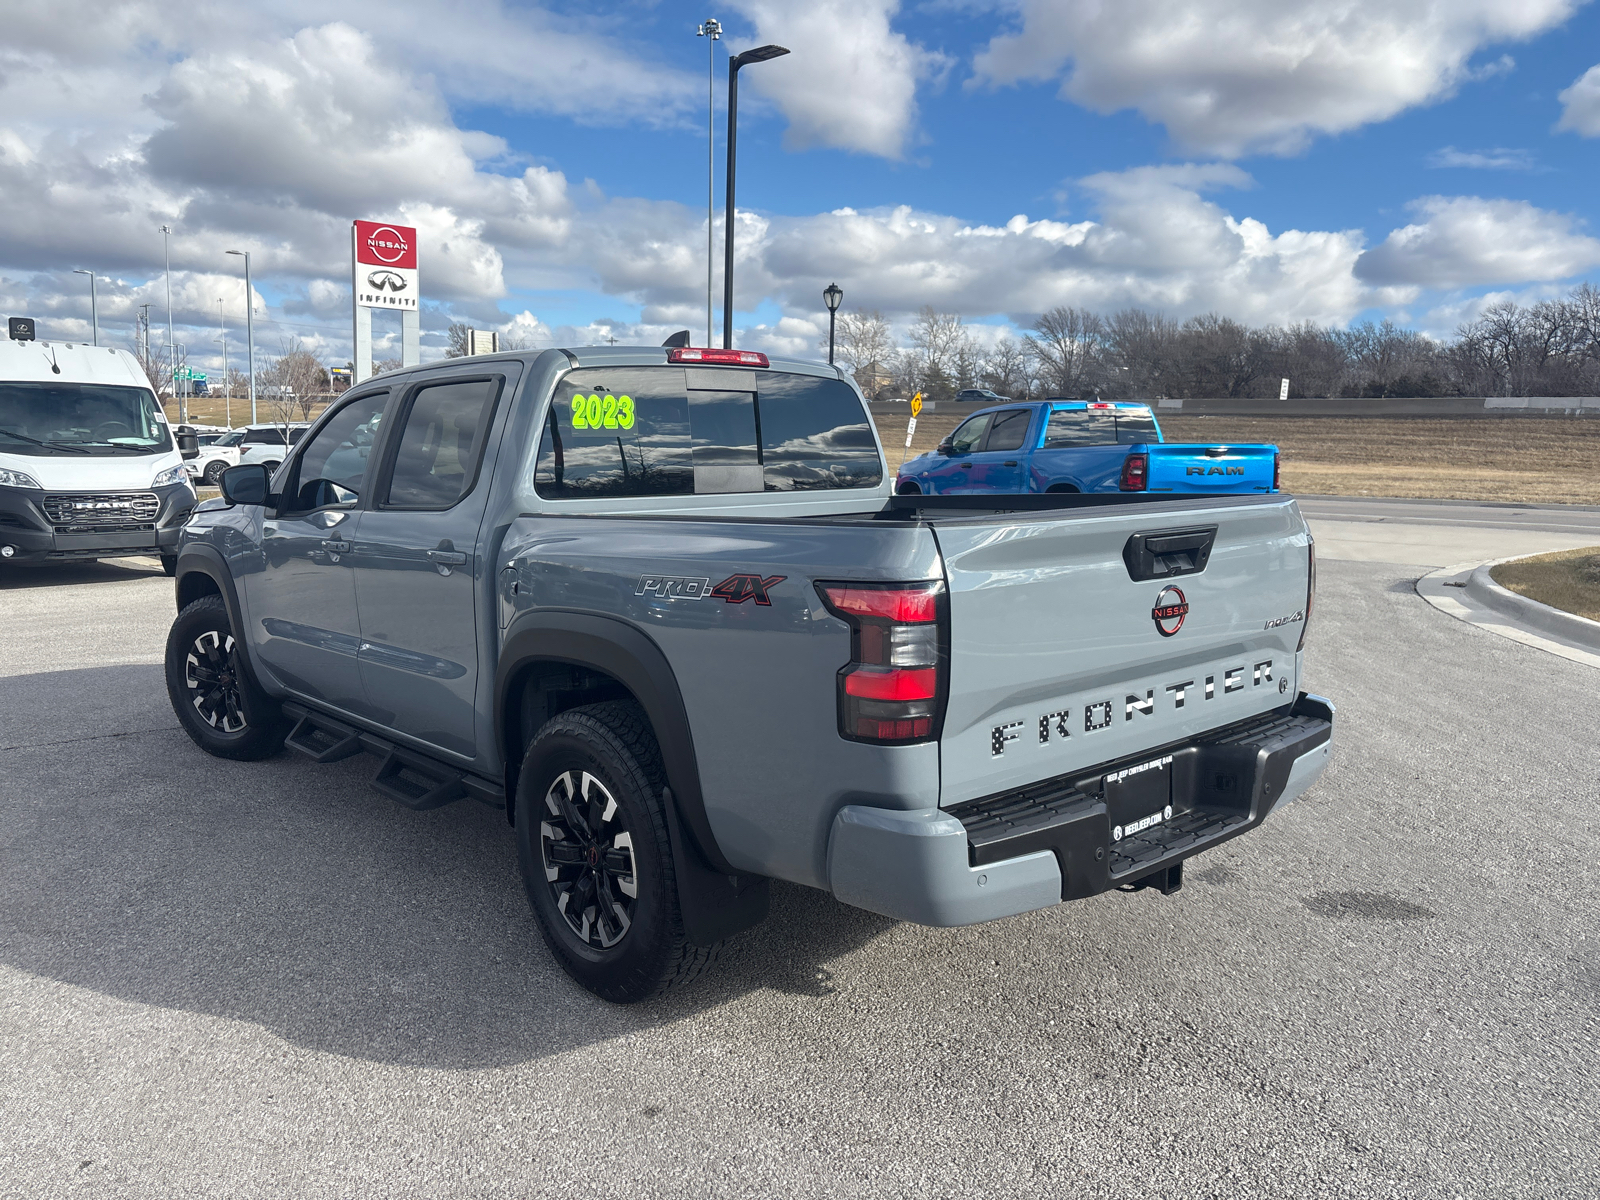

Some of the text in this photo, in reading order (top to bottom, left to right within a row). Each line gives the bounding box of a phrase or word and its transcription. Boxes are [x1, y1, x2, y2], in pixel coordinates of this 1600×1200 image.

[367, 239, 408, 250] NISSAN
[360, 294, 416, 306] INFINITI
[571, 394, 635, 430] 2023
[1186, 466, 1245, 476] RAM
[1154, 604, 1189, 617] NISSAN
[991, 659, 1273, 757] FRONTIER
[1118, 770, 1128, 779] JEEP
[1129, 763, 1148, 775] CHRYSLER
[1163, 755, 1172, 764] RAM
